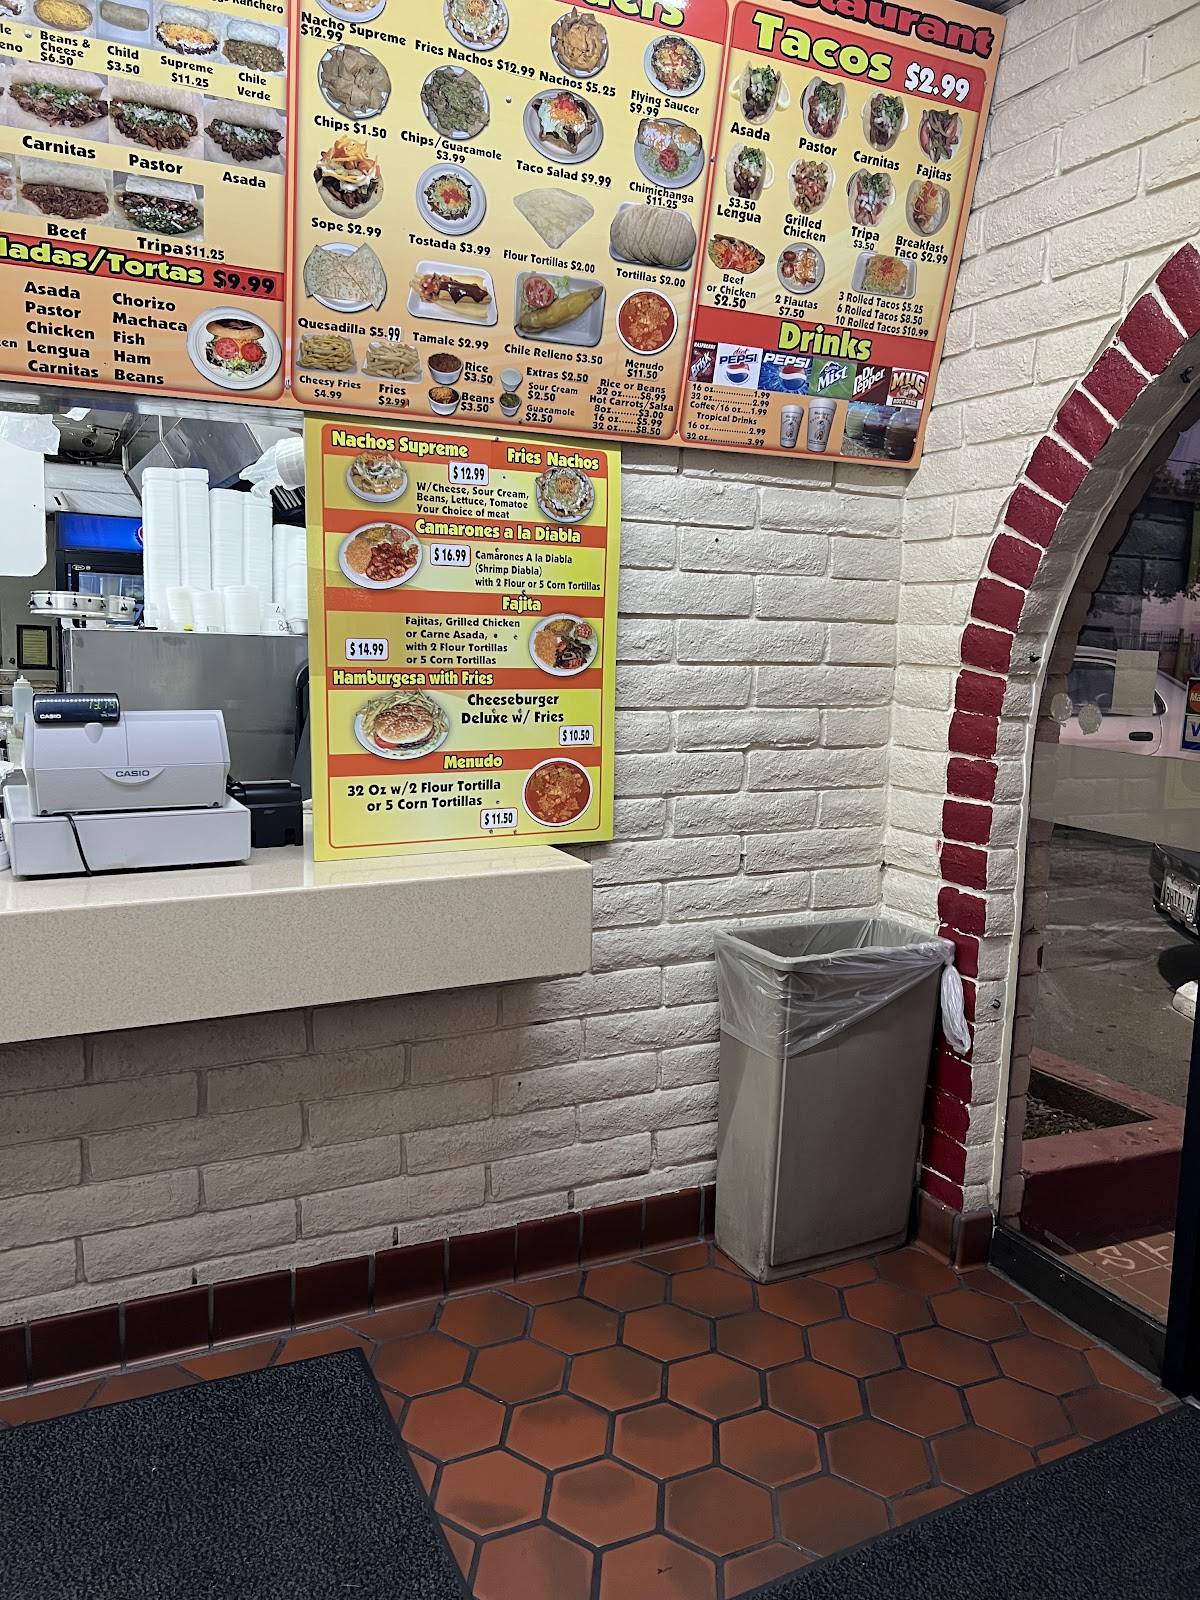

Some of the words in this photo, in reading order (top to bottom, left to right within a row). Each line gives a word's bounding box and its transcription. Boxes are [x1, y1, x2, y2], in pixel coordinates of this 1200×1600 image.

[300, 23, 342, 42] $12.99
[301, 12, 345, 31] Nacho
[349, 23, 406, 46] Supreme
[40, 31, 78, 48] Beans
[40, 42, 84, 58] Cheese
[40, 52, 74, 66] $6.50
[107, 45, 139, 60] Child
[415, 40, 443, 56] Fries
[447, 48, 493, 68] Nachos
[496, 59, 535, 78] $12.99
[752, 10, 893, 82] Tacos
[904, 62, 970, 103] $2.99
[106, 60, 140, 74] $3.50
[160, 56, 214, 74] Supreme
[171, 73, 209, 88] $11.25
[238, 72, 267, 86] Chile
[539, 70, 583, 89] Nachos
[586, 82, 616, 97] $5.25
[237, 86, 271, 101] Verde
[631, 90, 662, 108] Flying
[664, 98, 700, 115] Saucer
[629, 102, 659, 118] $9.99
[314, 115, 350, 132] Chips
[353, 122, 387, 138] $1.50
[730, 121, 770, 141] Asada
[22, 136, 96, 159] Carnitas
[400, 130, 502, 161] Chips/Guacamole
[799, 137, 837, 157] Pastor
[128, 154, 183, 174] Pastor
[436, 150, 466, 164] $3.99
[853, 150, 900, 171] Carnitas
[223, 171, 266, 188] Asada
[516, 160, 543, 175] Taco
[547, 166, 578, 181] Salad
[581, 172, 612, 188] $9.99
[916, 163, 952, 182] Fajitas
[629, 181, 694, 203] Chimichanga
[646, 194, 678, 210] $11.25
[728, 197, 756, 211] $3.50
[717, 204, 762, 224] Lengua
[785, 213, 822, 230] Grilled
[47, 223, 87, 240] Beef
[311, 217, 343, 233] Sope
[347, 222, 381, 238] $2.99
[783, 225, 826, 242] Chicken
[851, 226, 880, 242] Tripa
[136, 237, 183, 255] Tripa
[409, 234, 456, 251] Tostada
[460, 242, 491, 256] $3.99
[853, 239, 875, 251] $3.50
[895, 236, 944, 254] Breakfast
[503, 249, 528, 262] Flour
[530, 253, 568, 269] Tortillas
[570, 260, 595, 273] $2.00
[894, 246, 918, 260] Taco
[920, 251, 948, 265] $2.99
[213, 270, 275, 294] $9.99
[616, 267, 656, 283] Tortillas
[659, 275, 686, 288] $2.00
[723, 274, 744, 285] Beef
[24, 281, 81, 300] Asada
[720, 285, 756, 299] Chicken
[25, 301, 81, 319] Pastor
[112, 293, 176, 312] Chorizo
[714, 294, 746, 308] $2.50
[783, 296, 818, 310] Flautas
[846, 292, 874, 305] Rolled
[876, 297, 900, 310] Tacos
[901, 302, 924, 314] $5.25
[778, 306, 804, 318] $7.50
[845, 304, 872, 317] Rolled
[875, 309, 898, 322] Tacos
[900, 314, 923, 325] $8.50
[26, 321, 95, 340] Chicken
[112, 312, 188, 332] Machaca
[298, 317, 366, 336] Quesadilla
[369, 326, 401, 341] $5.99
[847, 317, 875, 330] Rolled
[877, 322, 900, 334] Tacos
[902, 326, 929, 337] $10.99
[113, 331, 146, 346] Fish
[413, 331, 454, 346] Tamale
[457, 338, 489, 350] $2.99
[778, 320, 873, 361] Drinks
[27, 340, 90, 359] Lengua
[114, 350, 151, 365] Ham
[504, 343, 530, 356] Chile
[534, 347, 573, 361] Relleno
[575, 352, 603, 365] $3.50
[28, 360, 99, 378] Carnitas
[465, 361, 489, 373] Rice
[625, 359, 664, 372] Menudo
[763, 352, 810, 368] PEPSI
[114, 368, 164, 386] Beans
[299, 375, 335, 388] Cheesy
[464, 372, 493, 384] $3.50
[526, 367, 559, 379] Extras
[561, 371, 588, 382] $2.50
[627, 368, 657, 379] $11.50
[817, 365, 849, 393] Mist
[862, 366, 875, 379] Dr
[379, 383, 406, 396] Fries
[852, 368, 886, 396] Pepper
[891, 372, 927, 395] MUG
[314, 389, 342, 399] $4.99
[461, 392, 495, 404] Beans
[460, 401, 489, 413] $3.50
[697, 412, 730, 423] Tropical
[332, 430, 395, 451] Nachos
[399, 436, 469, 458] Supreme
[507, 447, 541, 465] Fries
[546, 450, 599, 470] Nachos
[416, 503, 440, 514] Your
[415, 518, 500, 538] Camarones
[534, 526, 581, 543] Diabla
[545, 553, 573, 564] Diabla
[475, 577, 493, 587] with
[546, 580, 566, 590] Corn
[568, 581, 600, 591] Tortillas
[501, 595, 542, 614] Fajita
[405, 616, 442, 627] Fajitas,
[445, 617, 479, 627] Grilled
[482, 618, 520, 628] Chicken
[420, 630, 449, 638] Carne
[453, 630, 488, 640] Asada,
[406, 642, 427, 651] with
[440, 643, 466, 652] Flour
[468, 643, 508, 652] Tortillas
[430, 655, 453, 664] Corn
[456, 656, 496, 665] Tortillas
[332, 669, 426, 688] Hamburgesa
[429, 670, 458, 685] with
[461, 670, 494, 686] Fries
[467, 693, 560, 707] Cheeseburger
[461, 711, 508, 724] Deluxe
[512, 709, 530, 724] w/
[534, 711, 564, 723] Fries
[442, 752, 504, 770] Menudo
[115, 770, 150, 778] CASIO
[347, 784, 364, 797] 32
[368, 784, 386, 795] Oz
[390, 781, 417, 796] w/2
[421, 782, 454, 794] Flour
[457, 779, 501, 791] Tortilla
[366, 802, 382, 812] or
[397, 798, 428, 810] Corn
[431, 796, 483, 809] Tortillas
